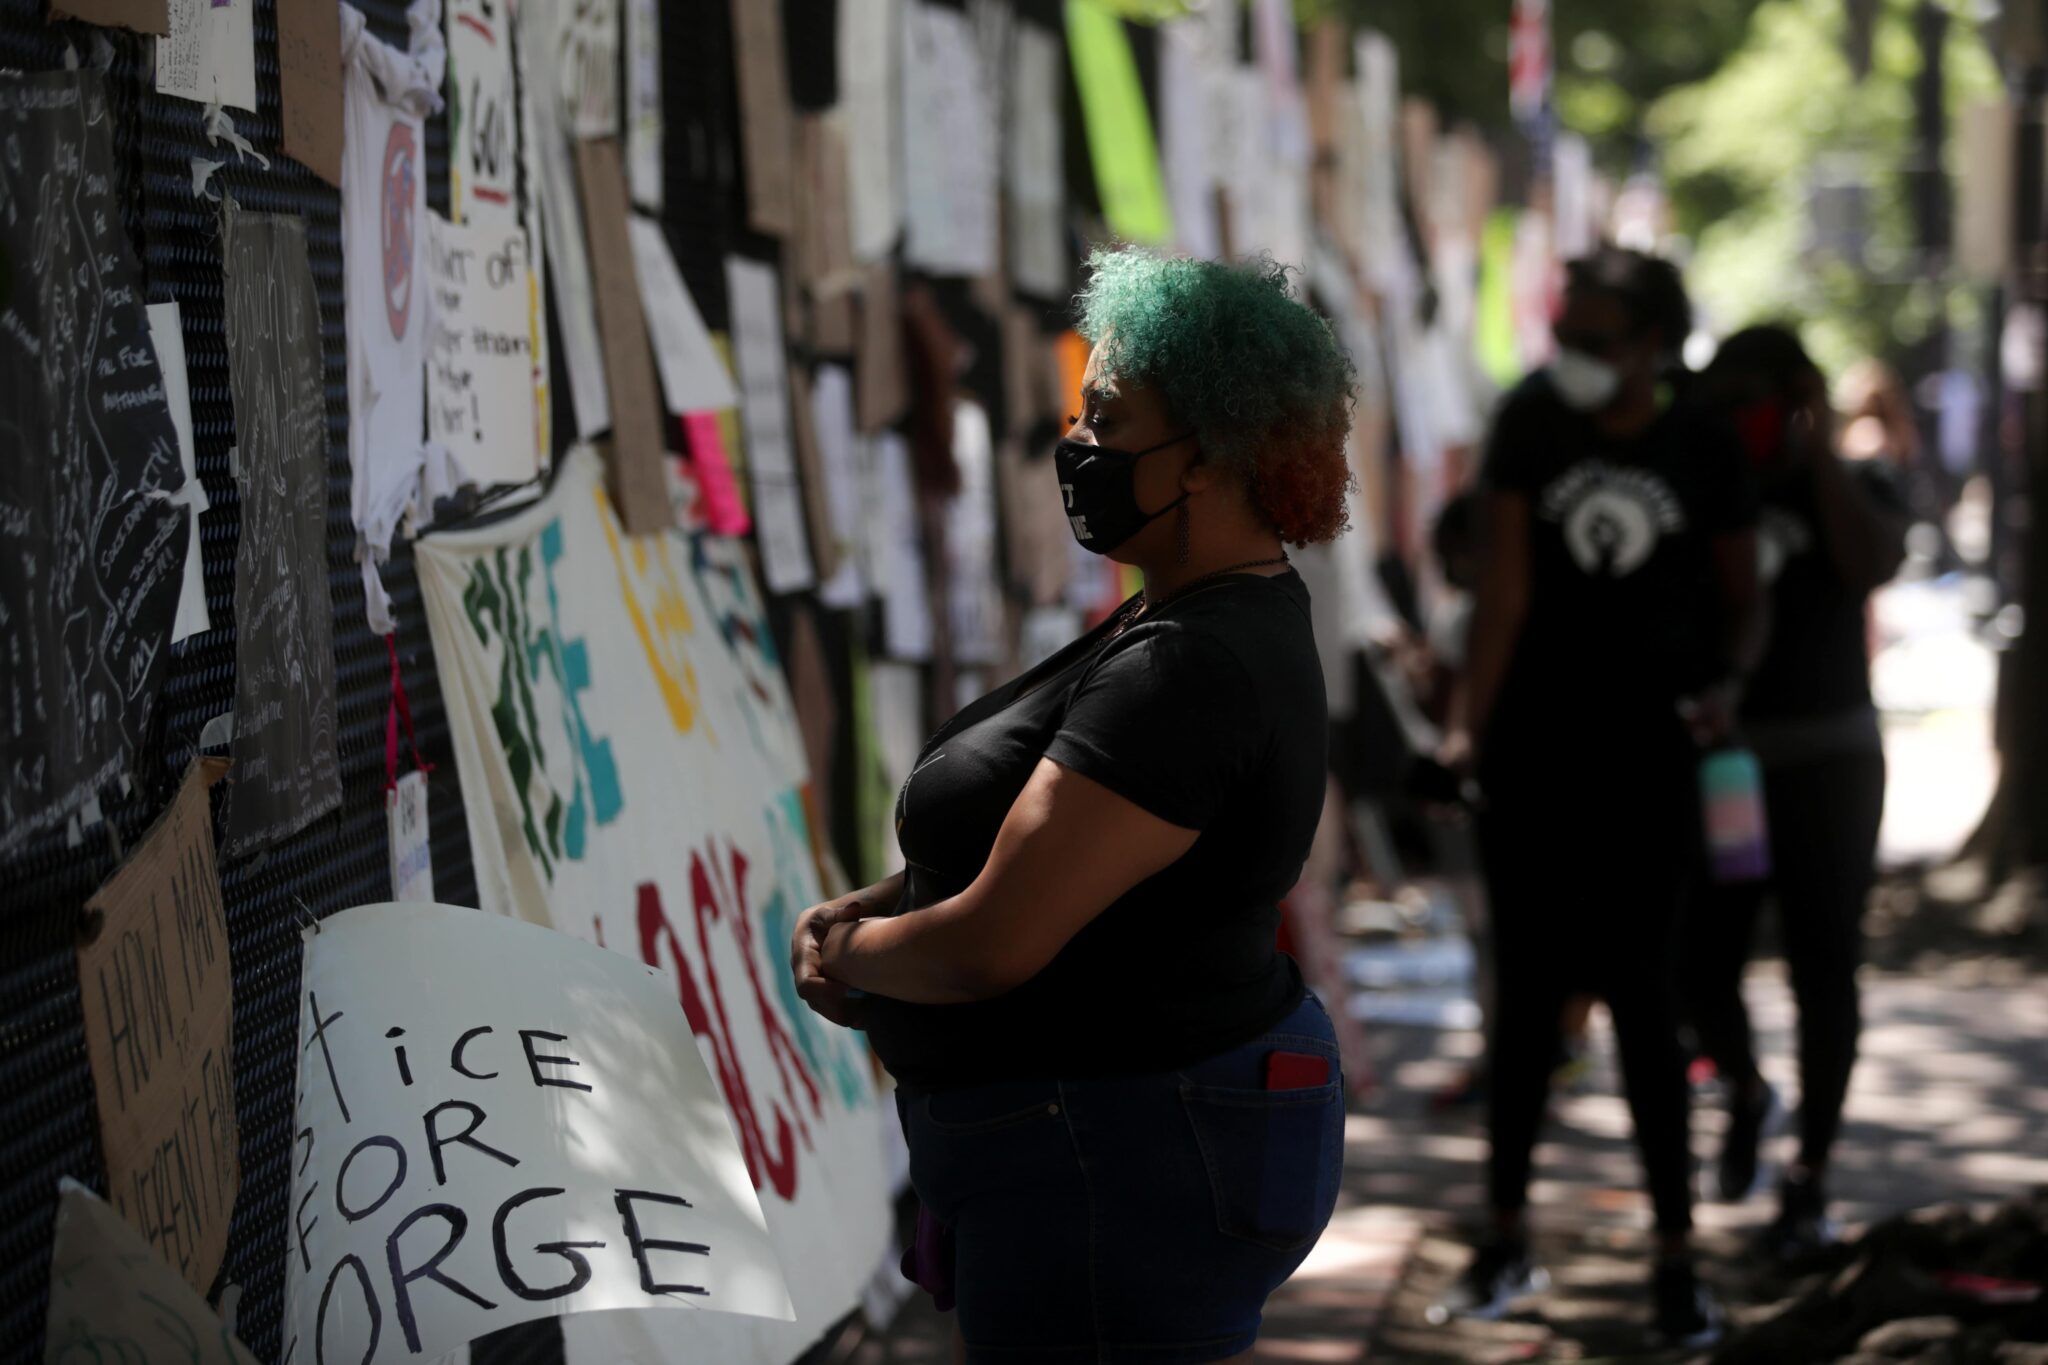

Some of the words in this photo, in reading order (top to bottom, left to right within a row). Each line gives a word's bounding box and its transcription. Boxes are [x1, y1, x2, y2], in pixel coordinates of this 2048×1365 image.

[98, 891, 175, 1111] HOW
[297, 1099, 520, 1272] FOR
[285, 1187, 712, 1365] ORGE
